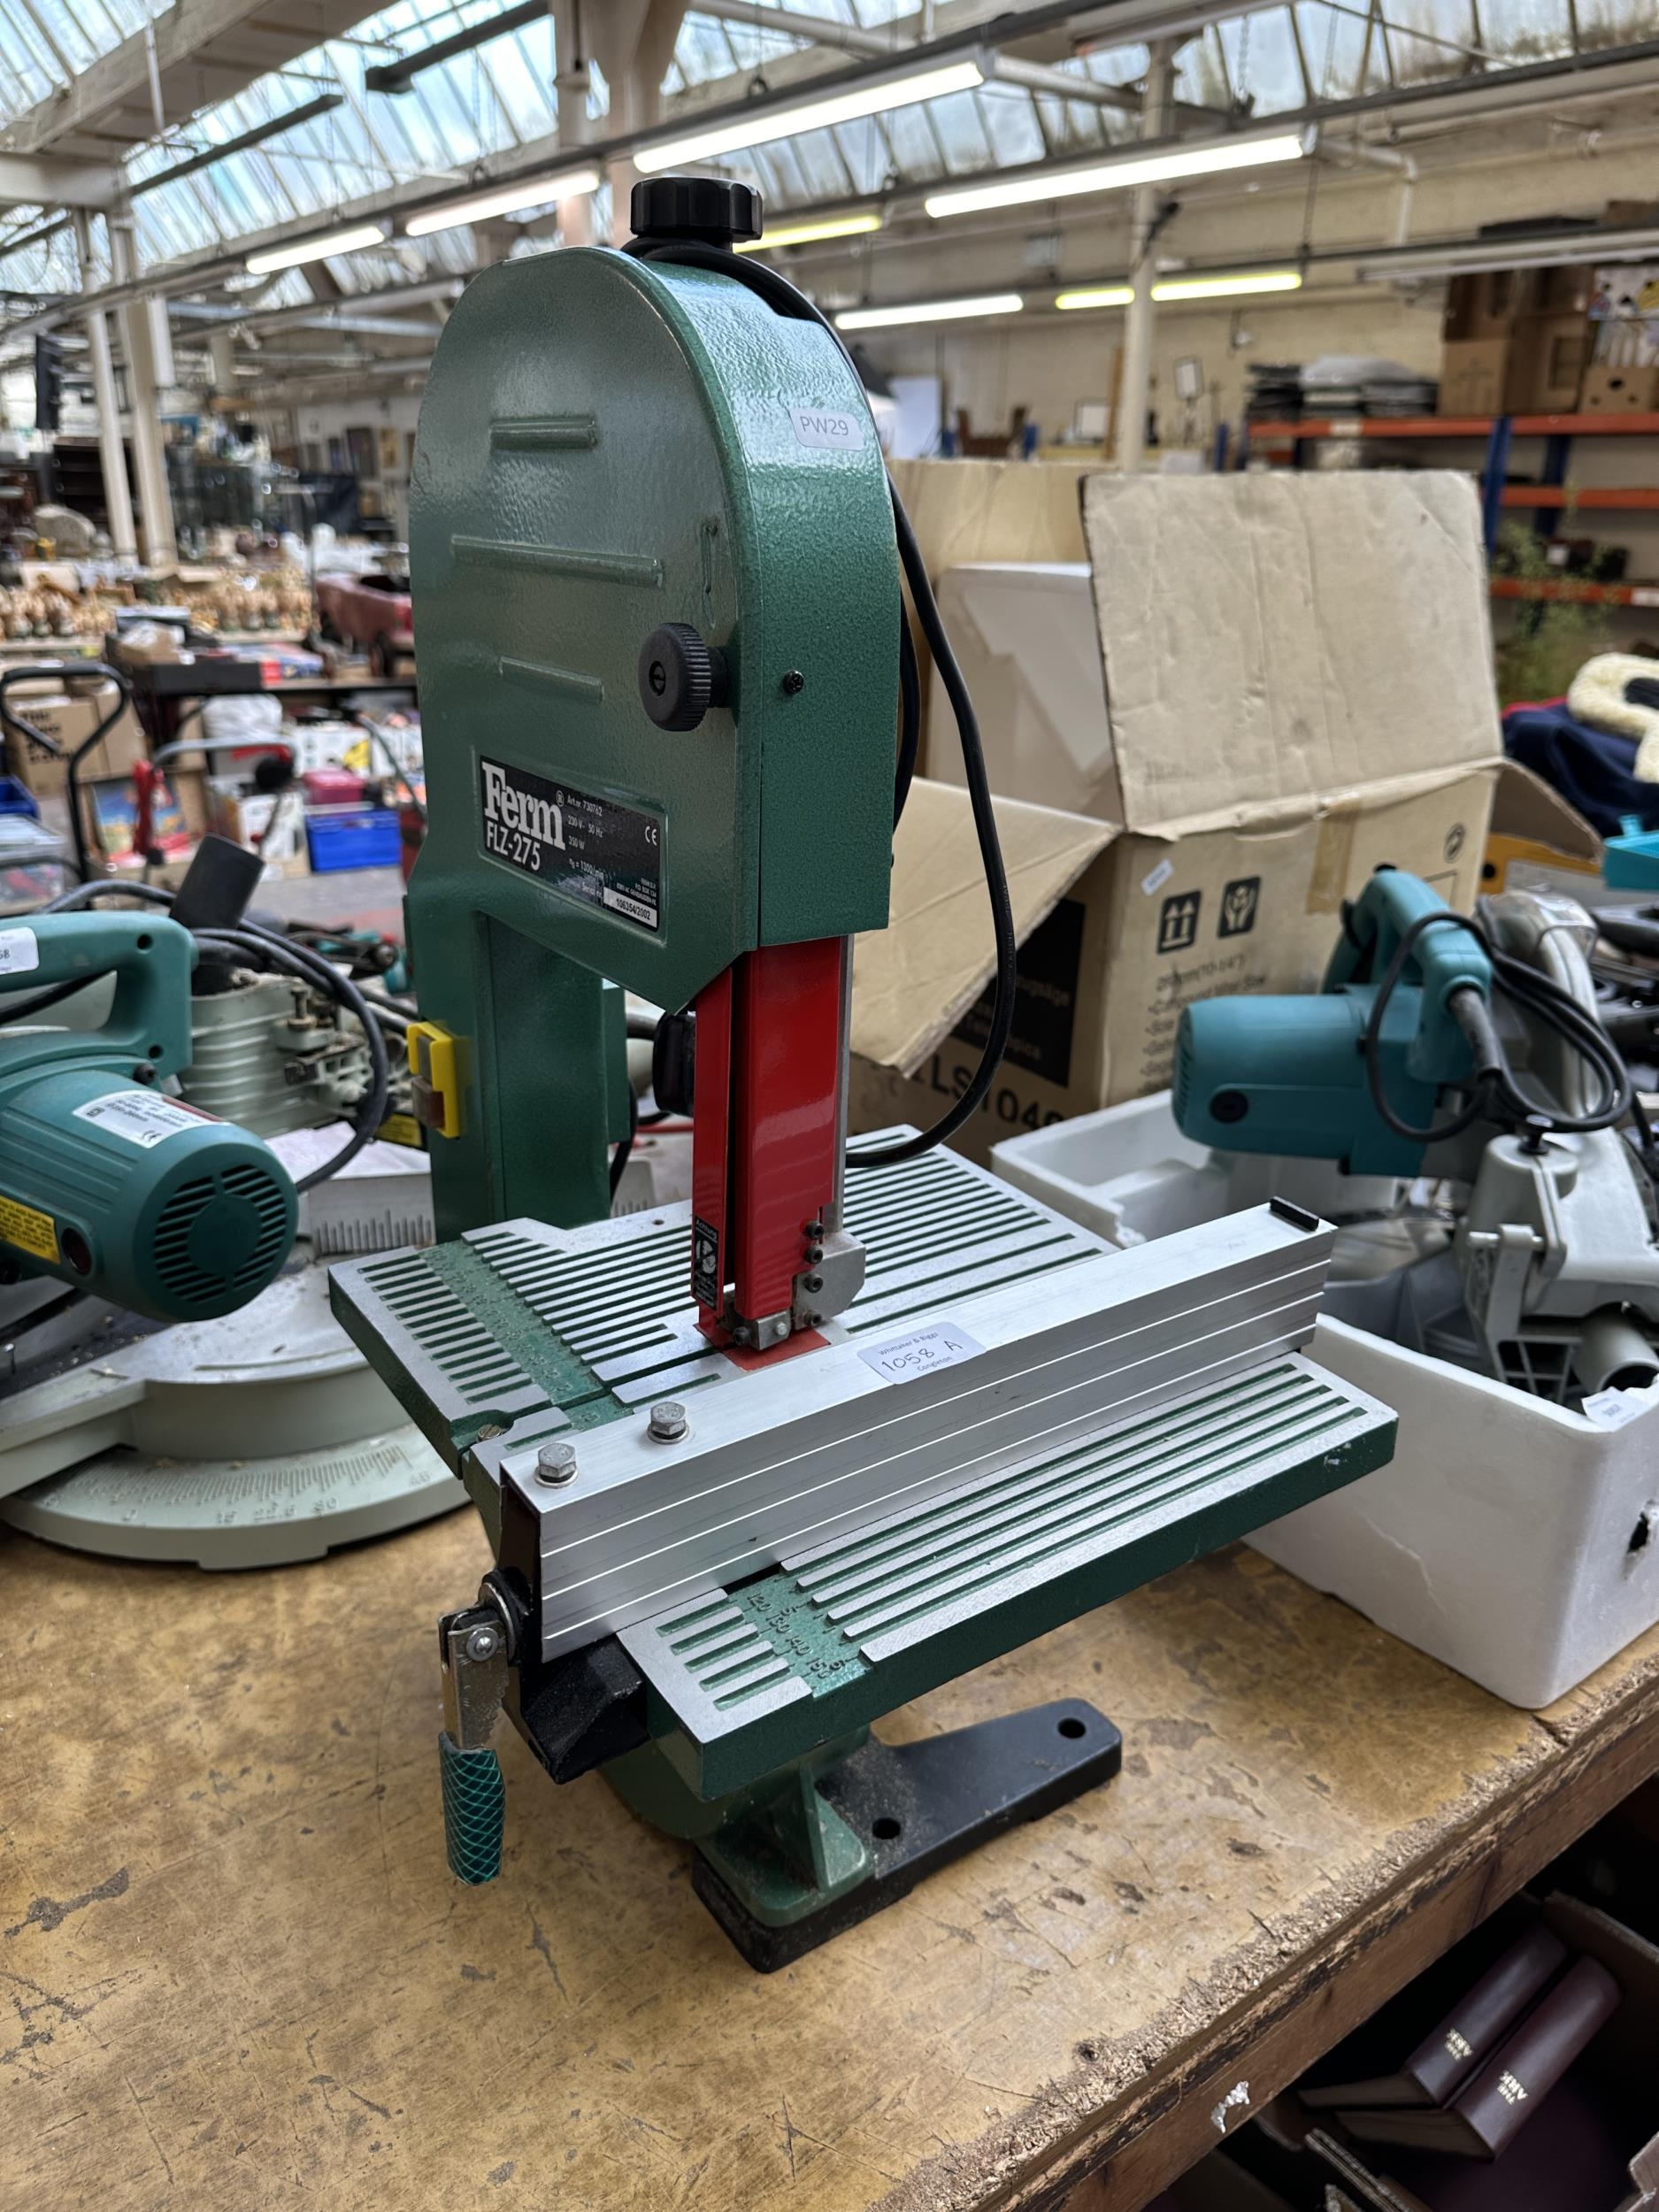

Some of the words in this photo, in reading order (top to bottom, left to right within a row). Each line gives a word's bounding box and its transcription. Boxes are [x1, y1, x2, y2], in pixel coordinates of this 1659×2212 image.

[800, 416, 849, 436] PW29
[481, 761, 566, 851] Ferm
[487, 820, 541, 872] FLZ-275
[881, 1348, 935, 1371] 1058
[943, 1340, 964, 1352] A
[917, 1356, 954, 1371] Congleton
[785, 1634, 813, 1656] 140
